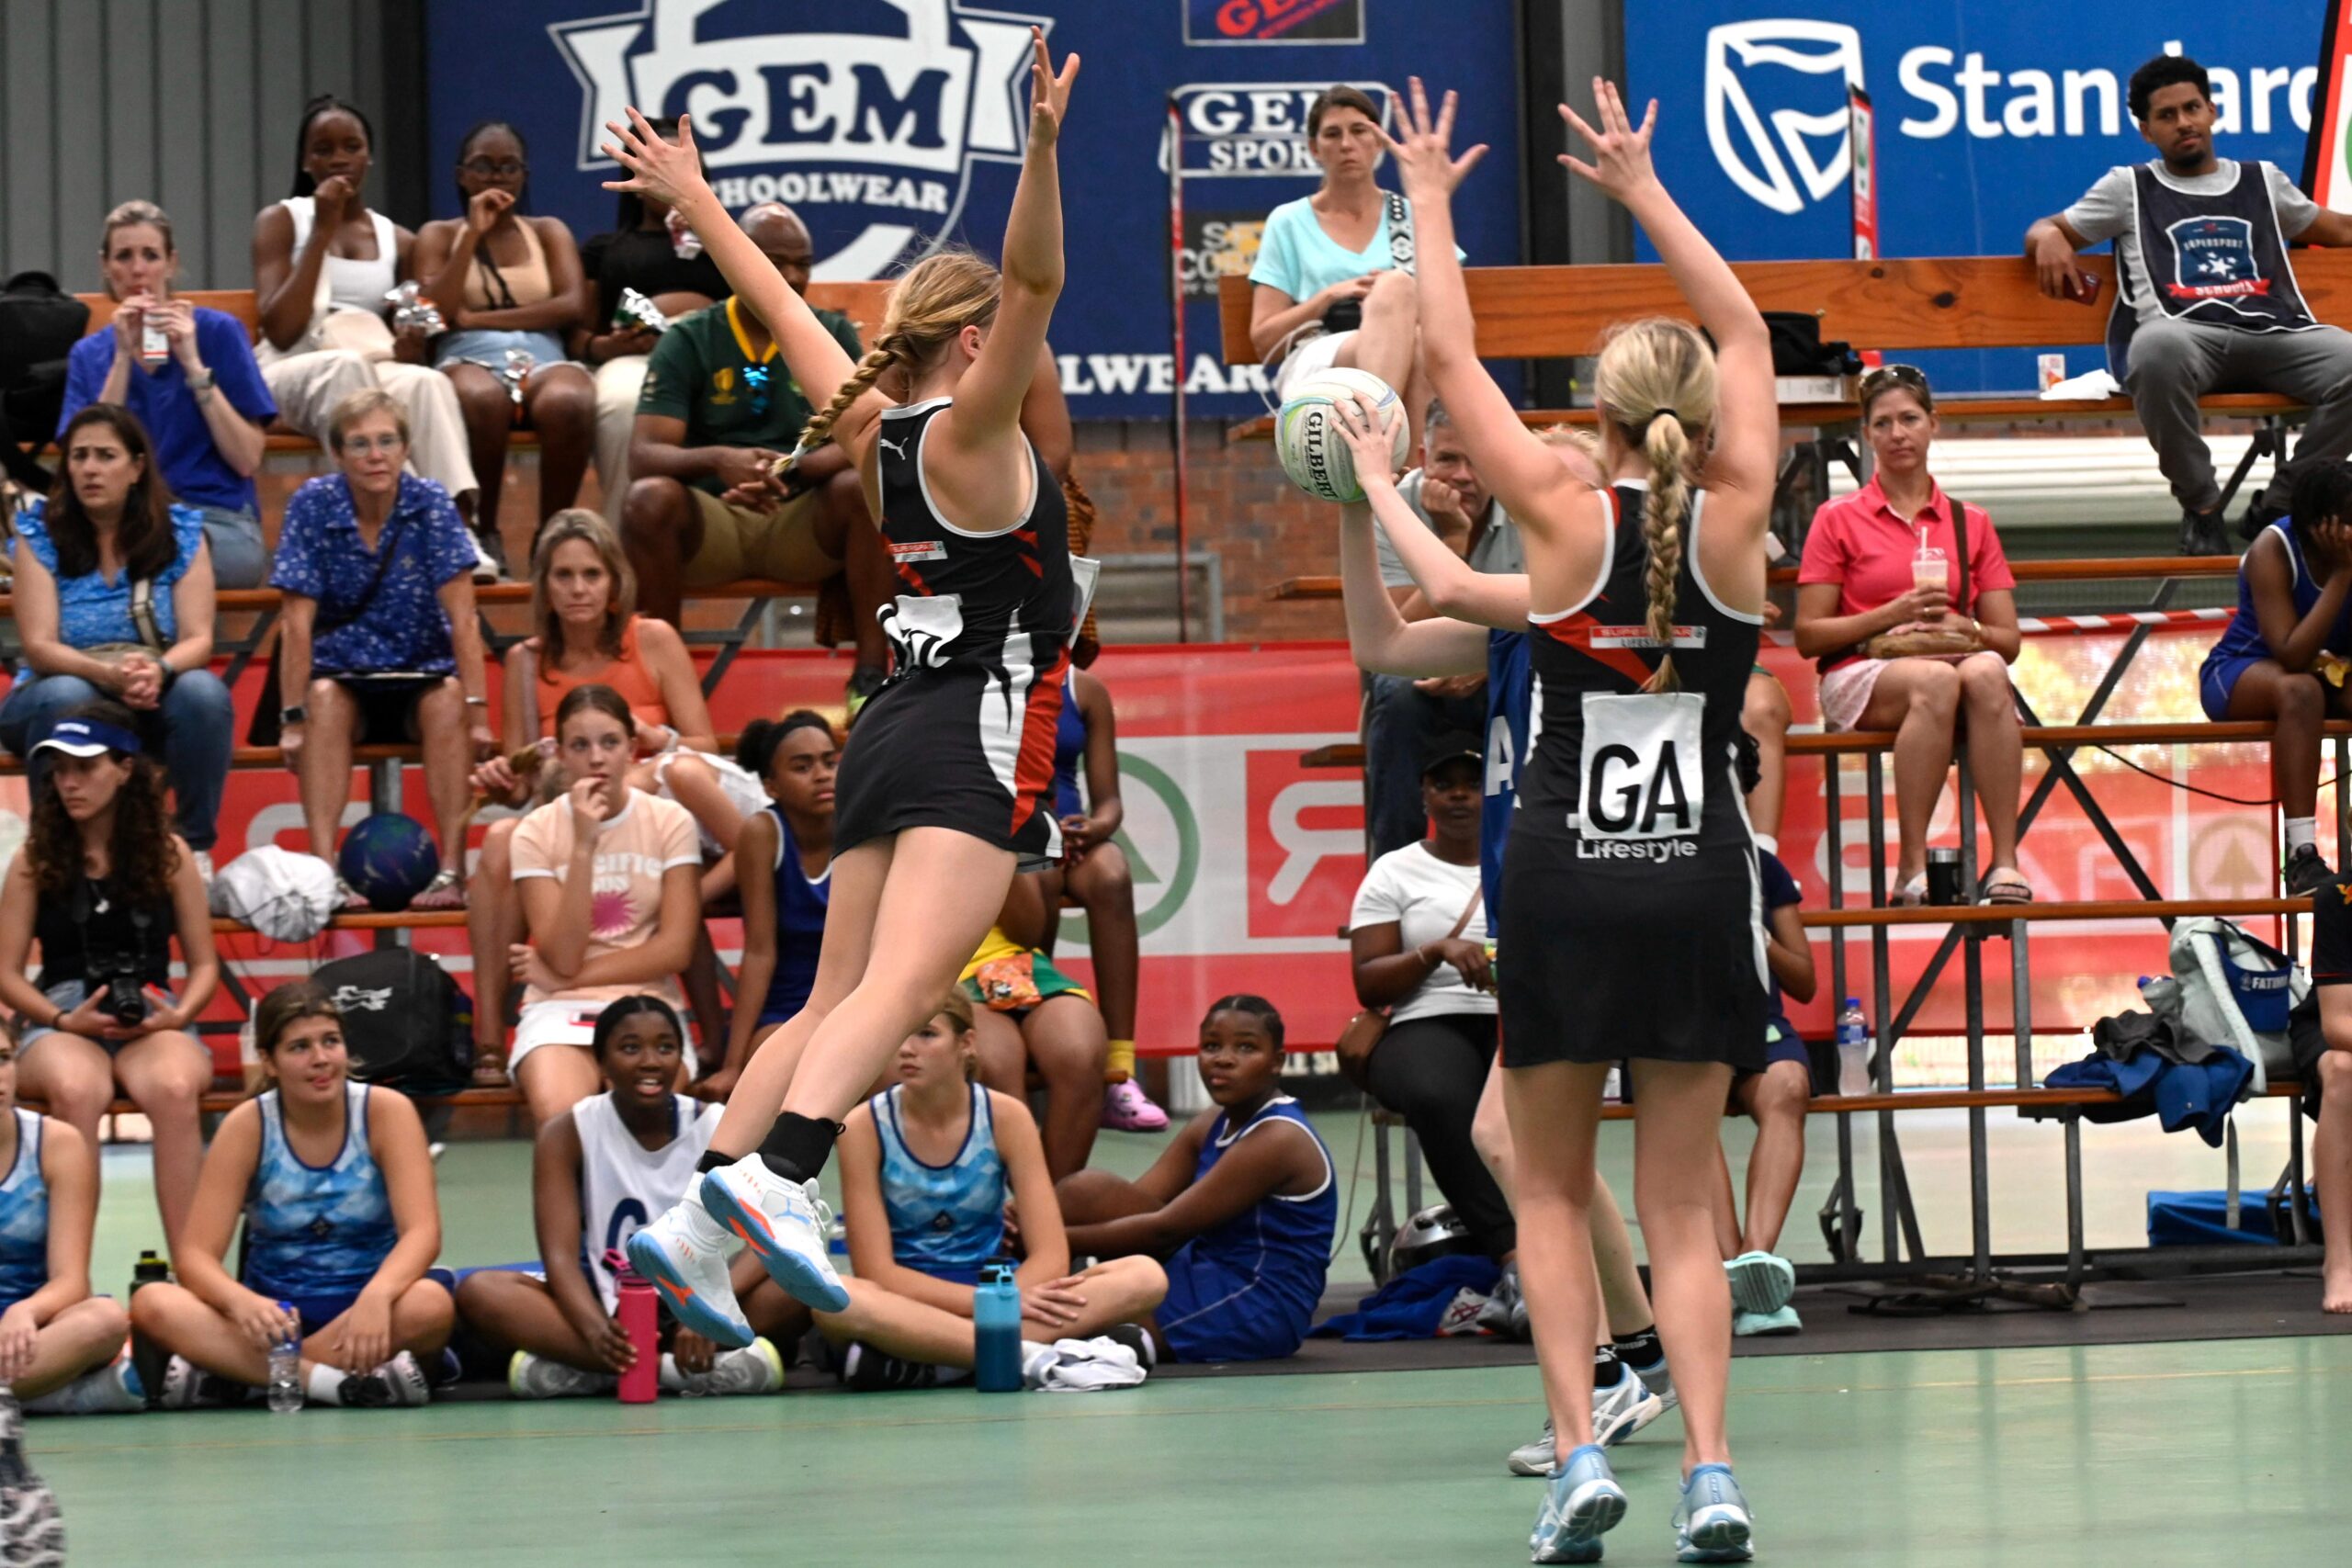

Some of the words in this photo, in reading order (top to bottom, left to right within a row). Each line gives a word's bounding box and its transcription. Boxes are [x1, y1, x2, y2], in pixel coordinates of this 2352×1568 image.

[661, 62, 951, 152] GEM
[1898, 39, 2319, 139] Stanar
[1208, 140, 1321, 172] SPOR
[711, 172, 948, 214] HOOLWEAR
[1057, 354, 1275, 395] LWEAR
[1307, 412, 1339, 498] GILBERT
[1588, 740, 1690, 833] GA
[1577, 840, 1698, 863] Lifestyle
